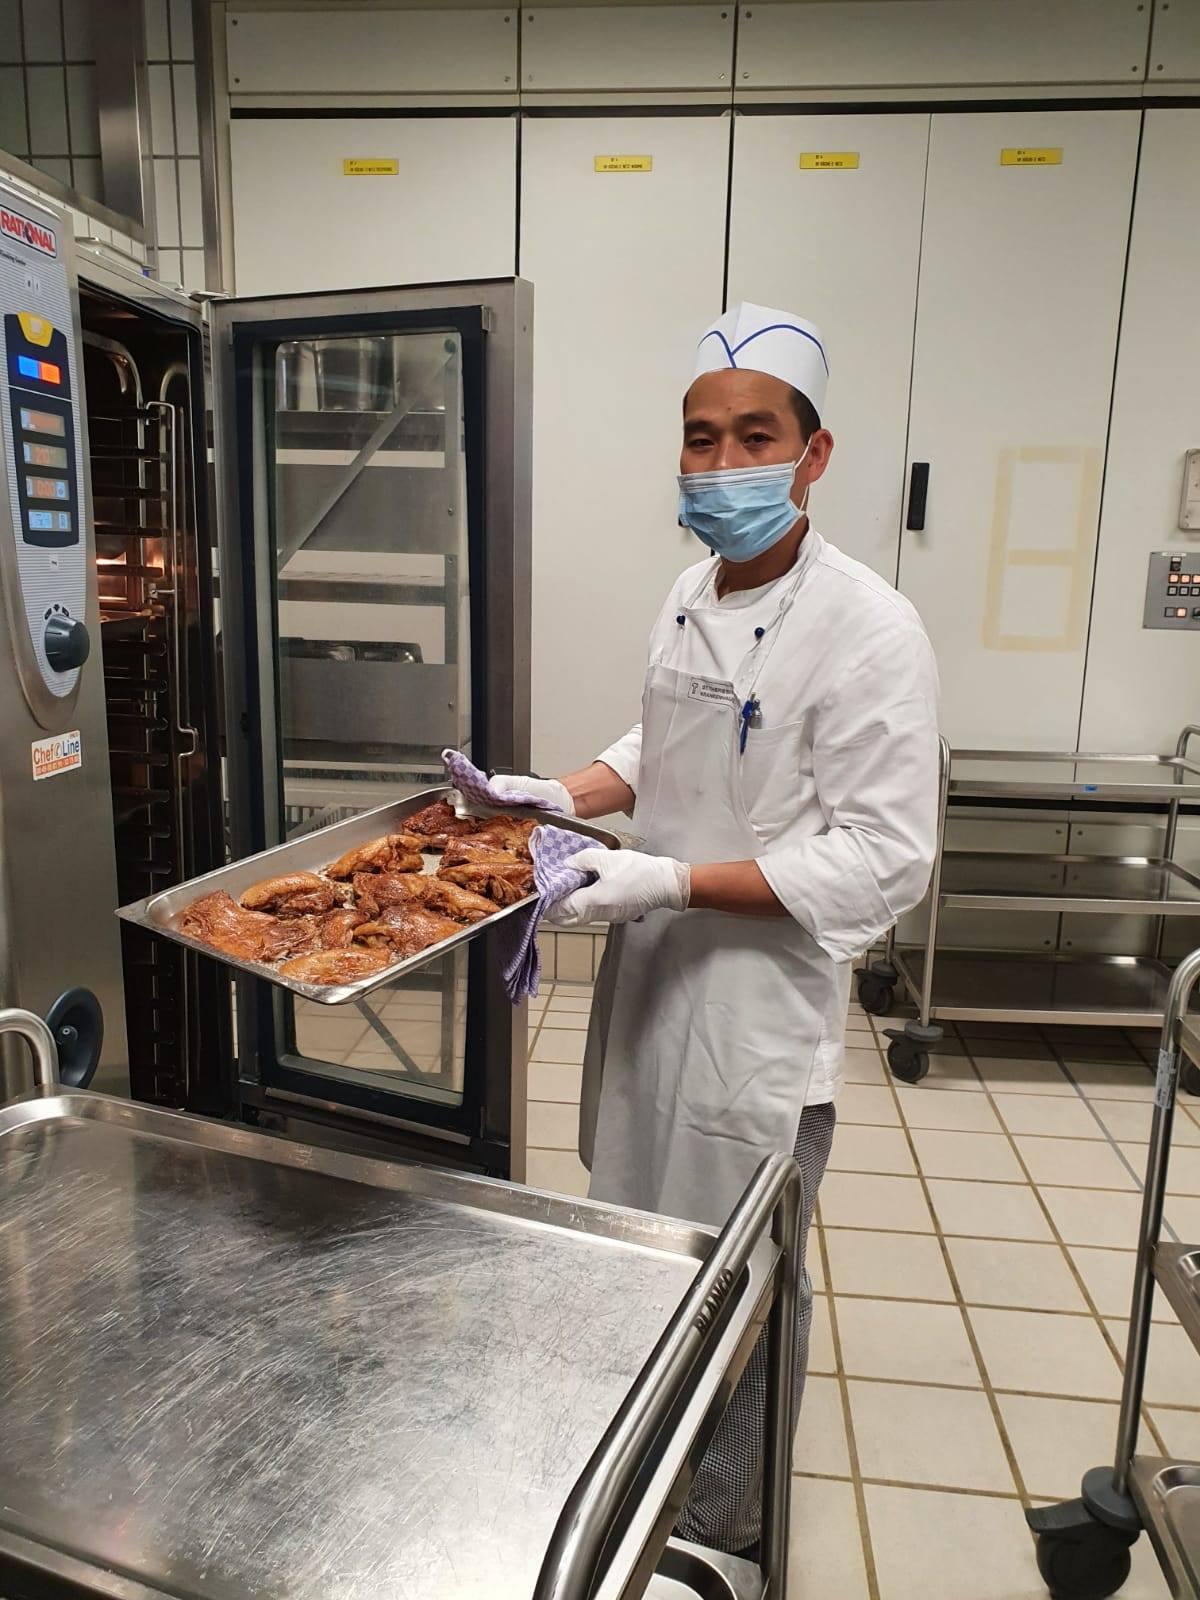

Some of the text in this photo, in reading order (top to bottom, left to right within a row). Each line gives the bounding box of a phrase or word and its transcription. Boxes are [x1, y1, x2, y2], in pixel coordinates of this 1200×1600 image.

[0, 209, 56, 252] RATIONAL
[33, 743, 54, 765] Chef
[62, 739, 80, 756] Line
[692, 1268, 733, 1338] BLANCO
